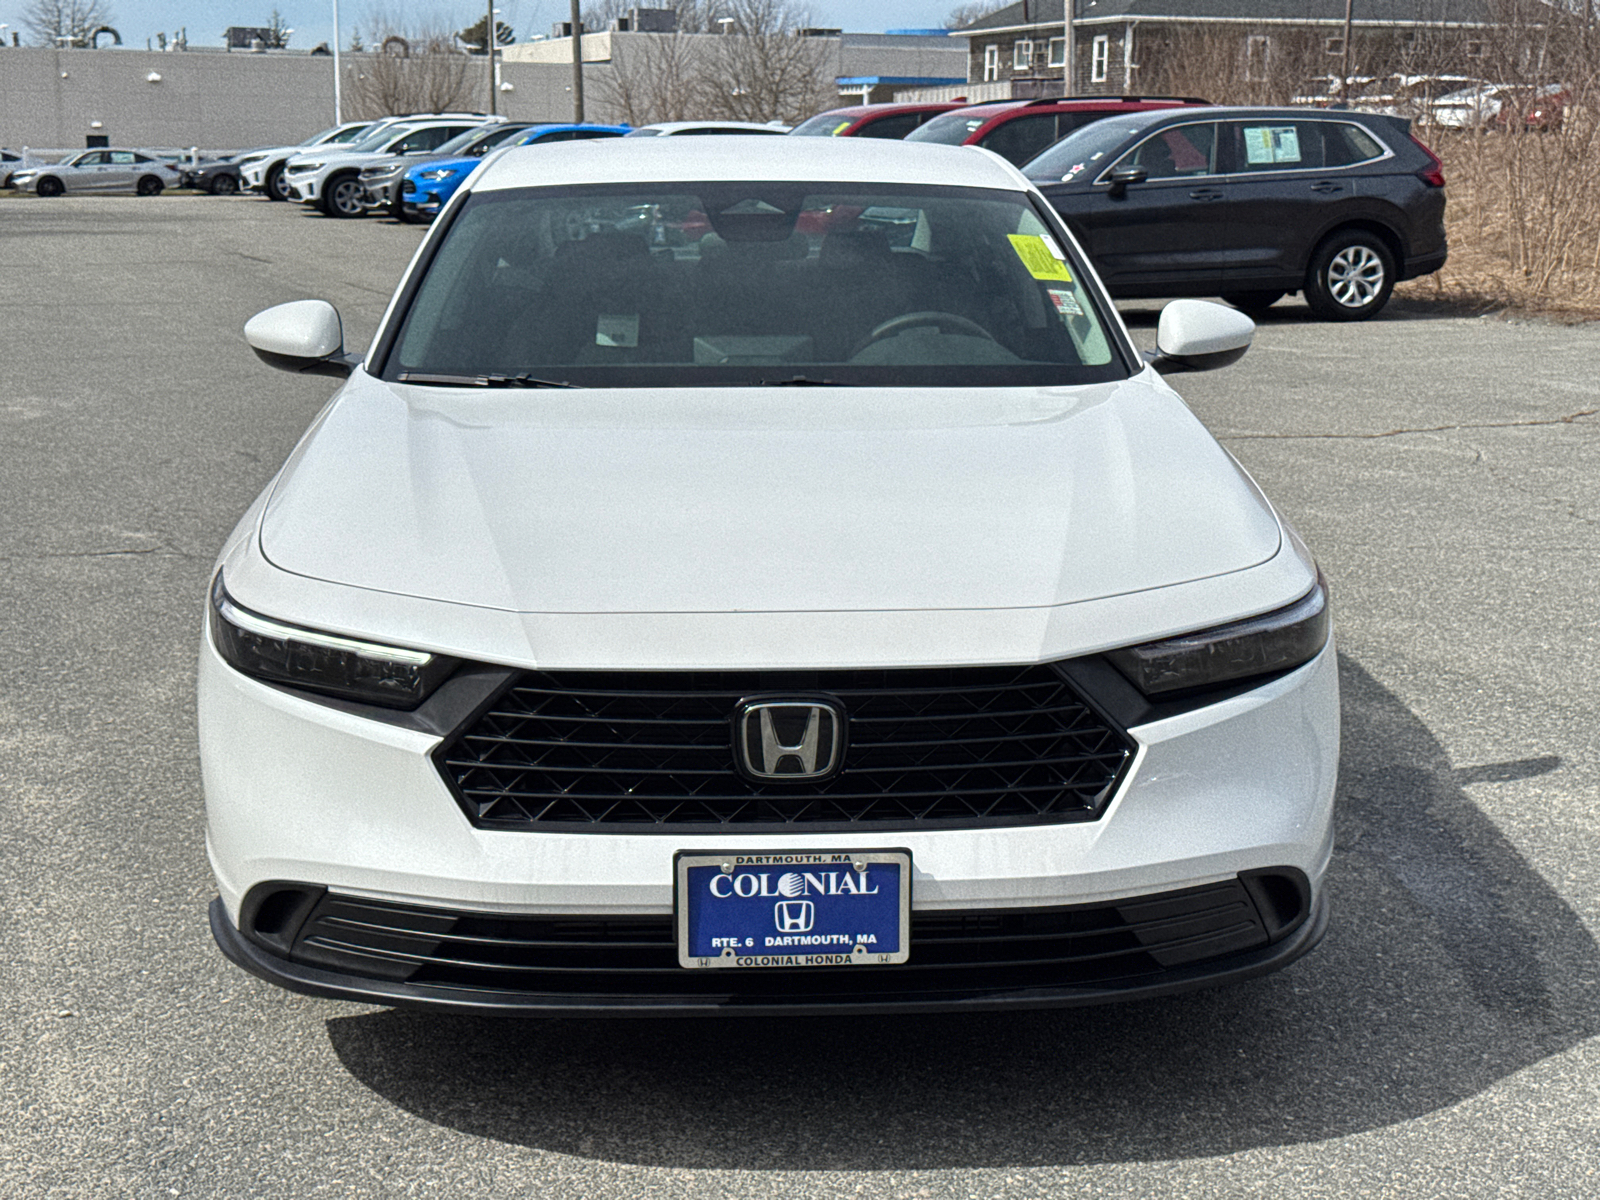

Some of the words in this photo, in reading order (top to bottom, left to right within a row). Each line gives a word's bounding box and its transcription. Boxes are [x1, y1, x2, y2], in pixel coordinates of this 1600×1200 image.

[735, 855, 827, 864] DARTMOUTH,
[831, 854, 852, 863] MA
[709, 871, 879, 898] COLONIAL
[711, 938, 742, 948] RTE.
[745, 937, 754, 947] 6
[764, 935, 853, 947] DARTMOUTH,
[856, 934, 877, 945] MA
[736, 956, 801, 966] COLONIAL
[805, 954, 853, 965] HONDA
